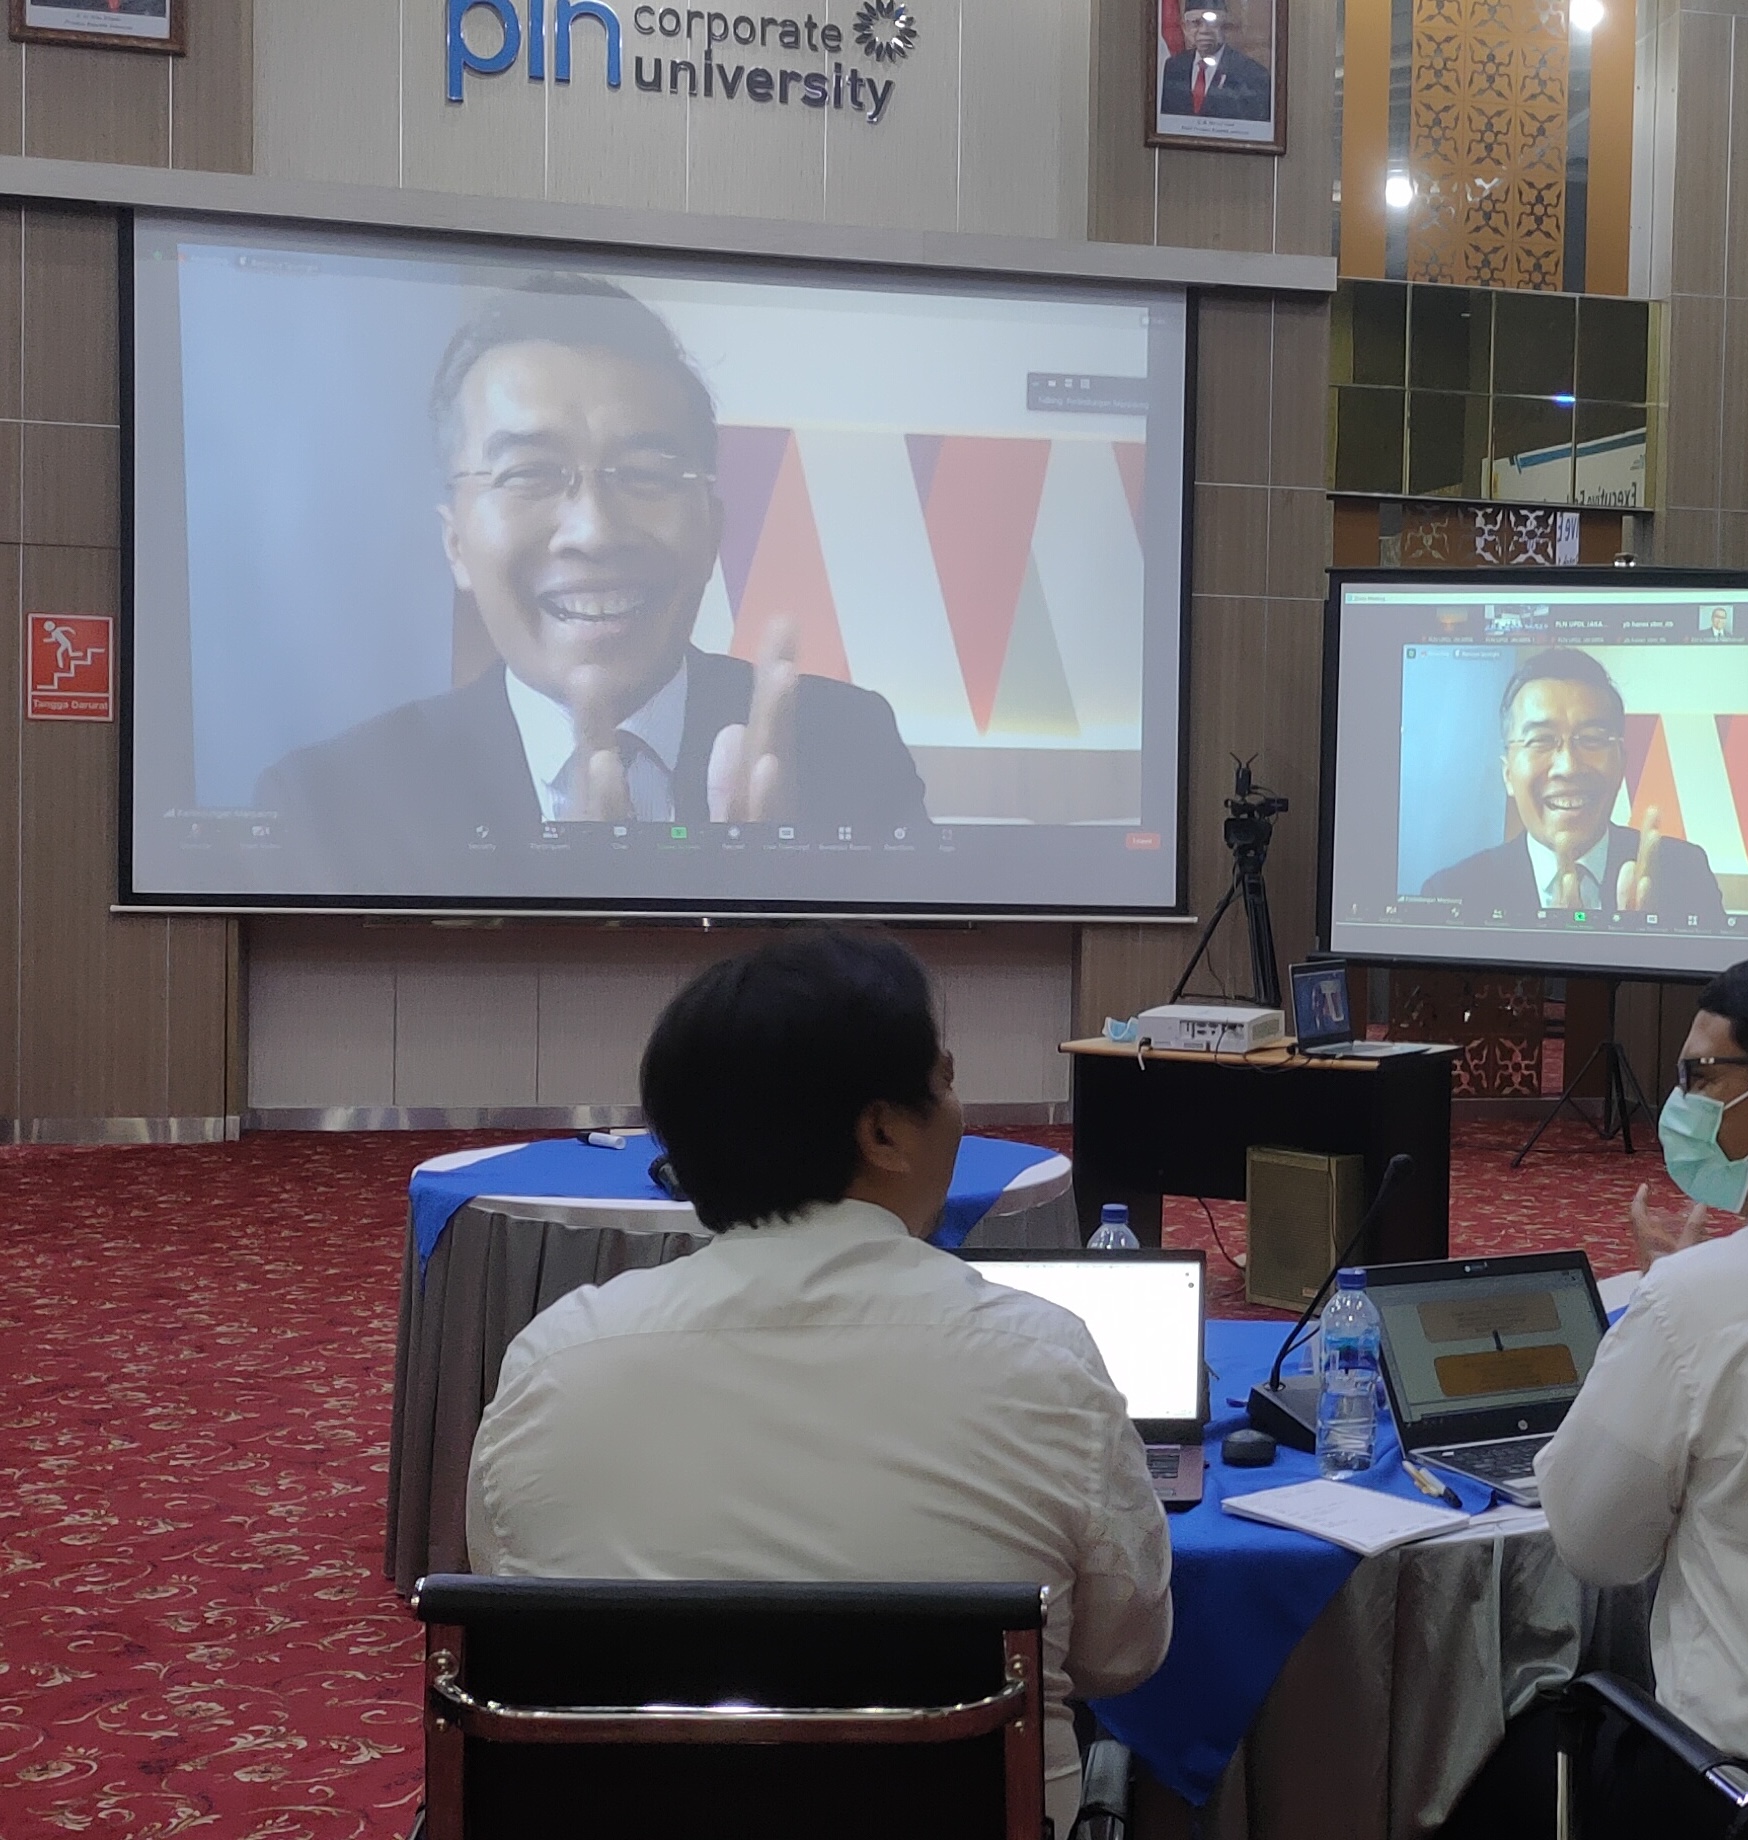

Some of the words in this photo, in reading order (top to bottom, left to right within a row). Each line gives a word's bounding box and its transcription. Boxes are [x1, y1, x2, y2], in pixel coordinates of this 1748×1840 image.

[634, 5, 842, 52] corporate
[635, 49, 894, 123] university
[33, 699, 69, 711] Tangga
[71, 700, 108, 711] Darurat
